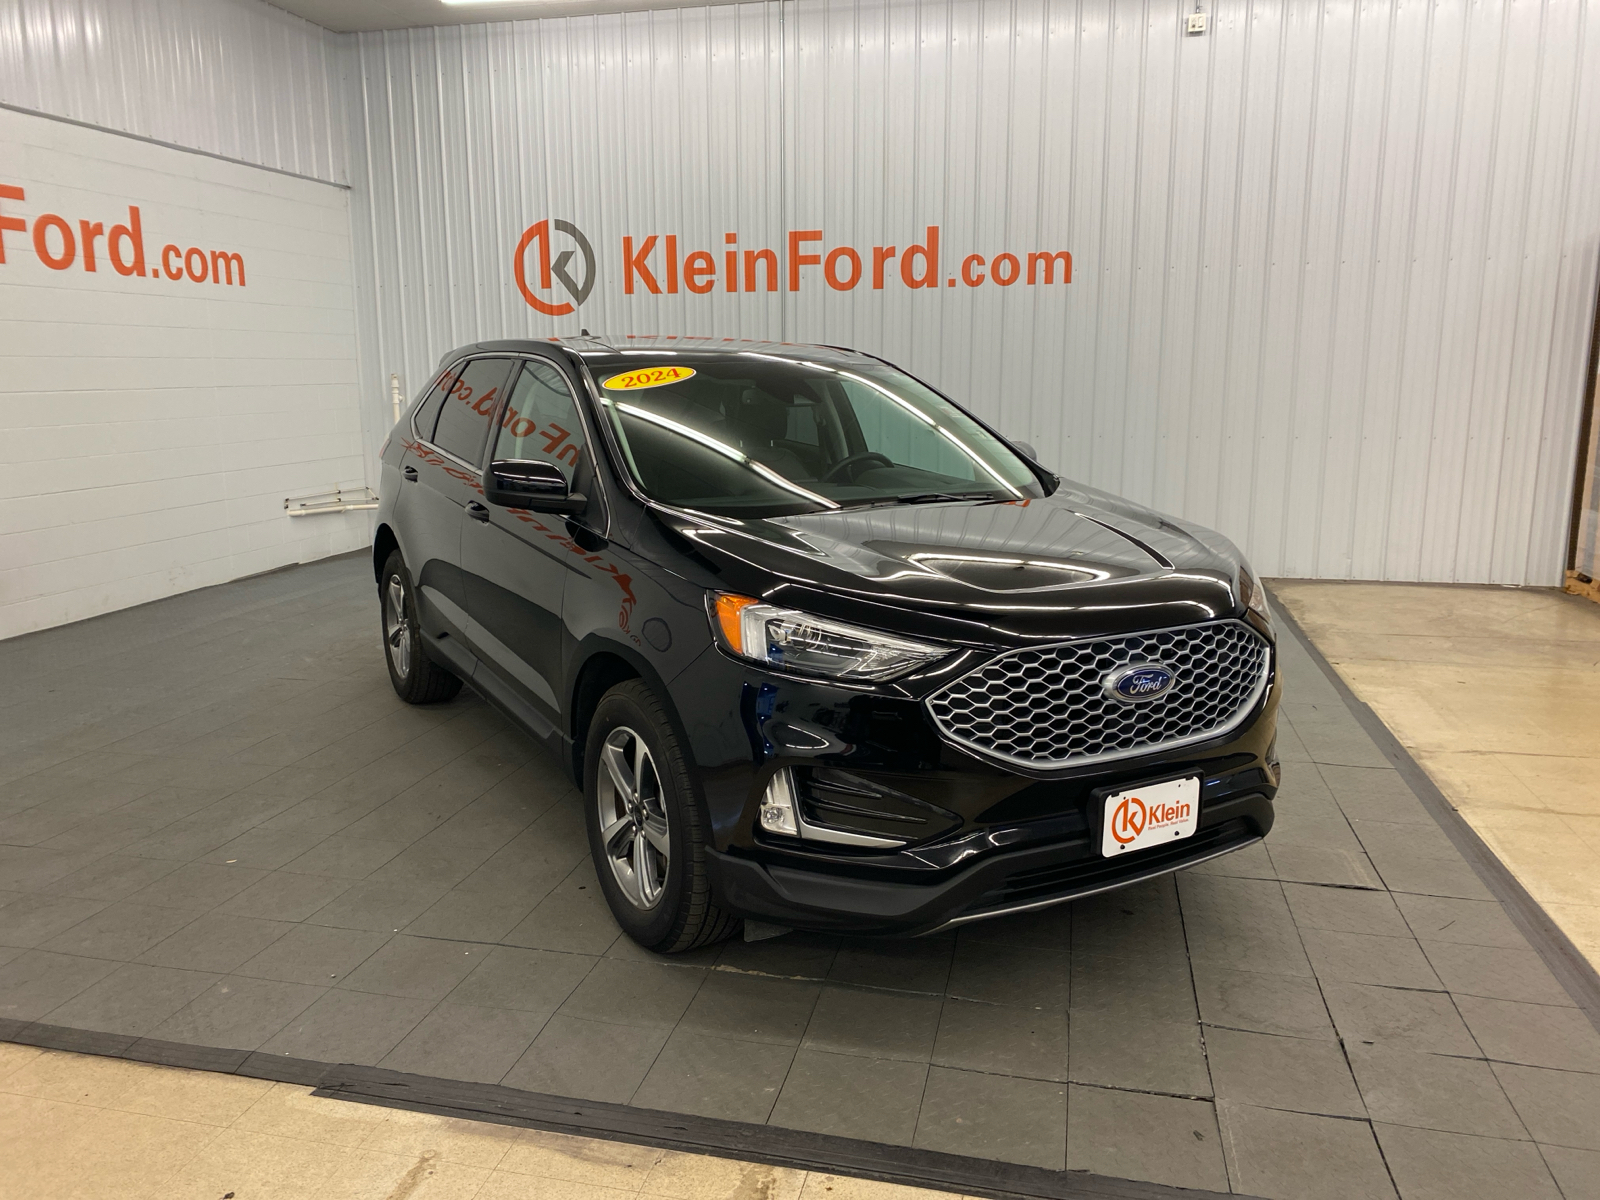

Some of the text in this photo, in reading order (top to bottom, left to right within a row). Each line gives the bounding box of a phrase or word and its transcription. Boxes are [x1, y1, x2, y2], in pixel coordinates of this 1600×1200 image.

[623, 225, 1074, 296] KleinFord.com
[621, 367, 681, 388] 2024
[1129, 673, 1162, 694] Ford
[1148, 800, 1190, 825] Klein
